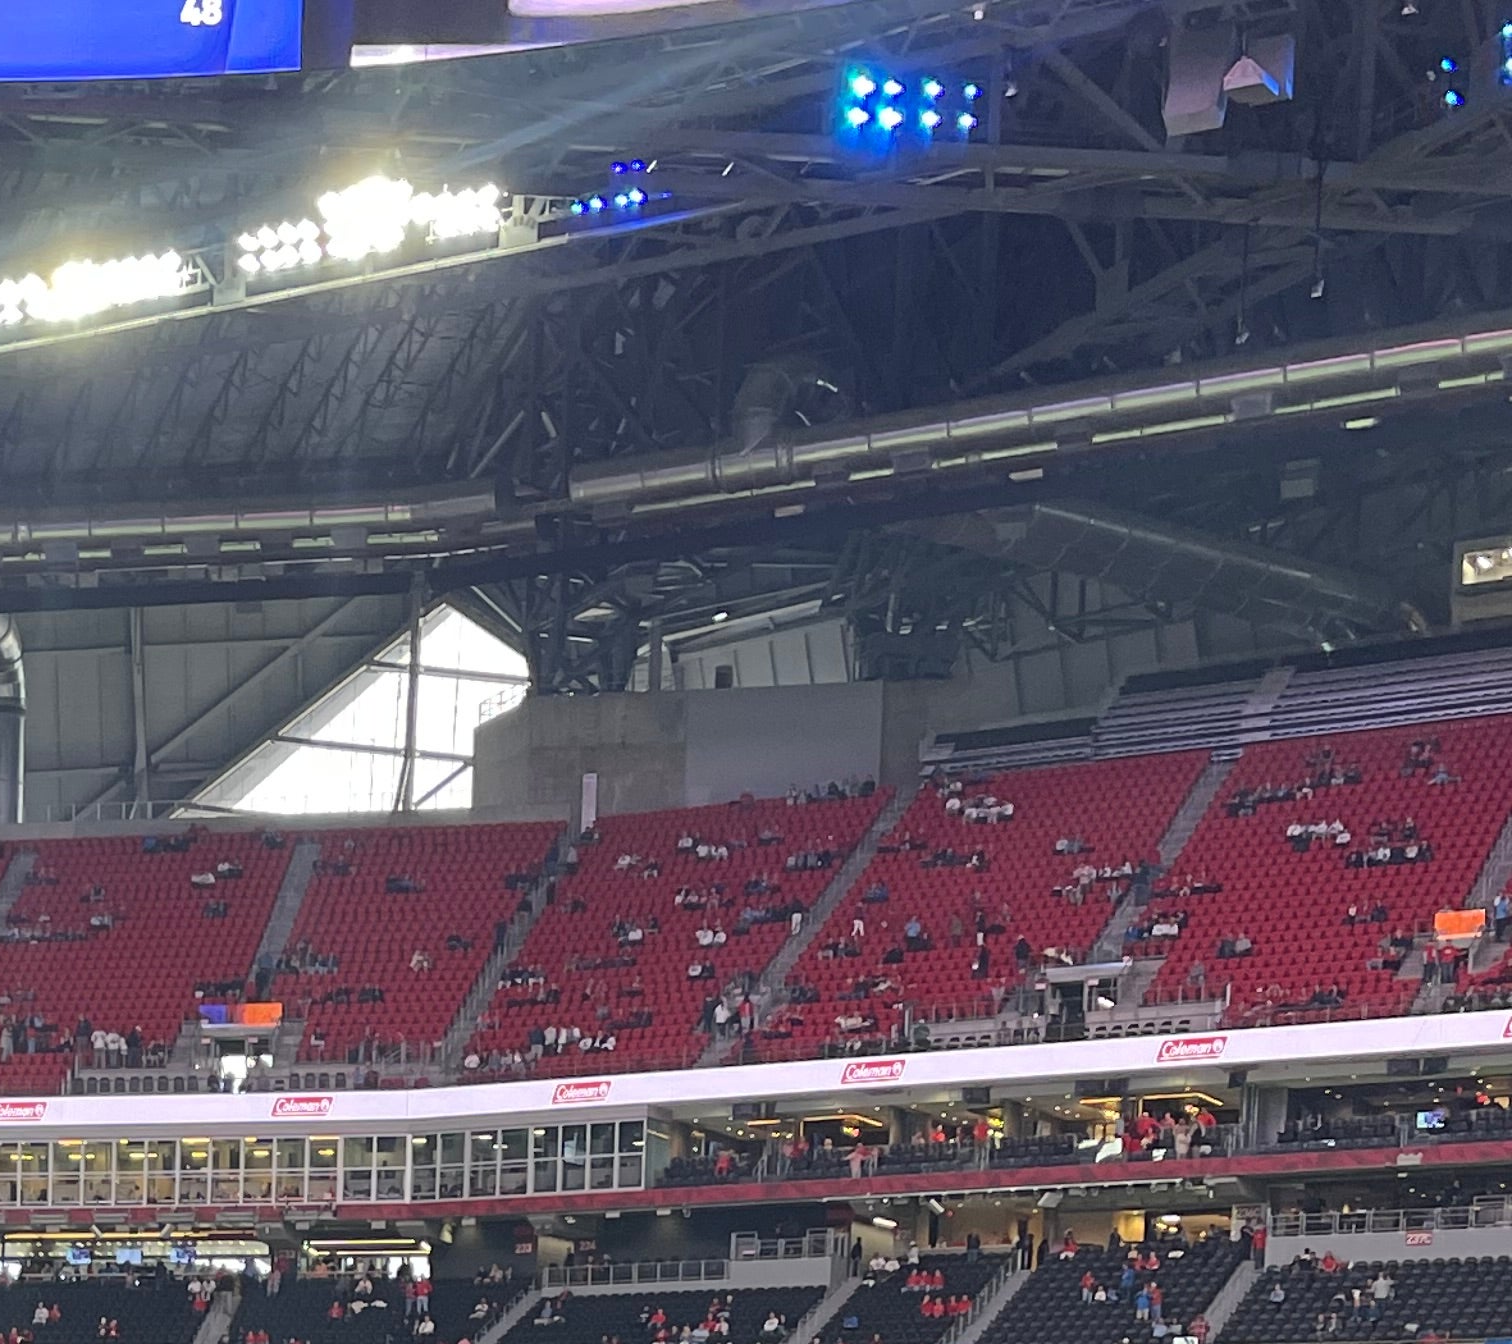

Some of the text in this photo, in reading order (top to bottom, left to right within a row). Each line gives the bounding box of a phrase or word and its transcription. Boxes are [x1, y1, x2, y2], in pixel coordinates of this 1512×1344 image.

[180, 0, 222, 26] 48
[1161, 1041, 1213, 1058] Coleman
[845, 1064, 892, 1080] Coleman
[556, 1084, 600, 1100] Coleman
[274, 1098, 320, 1112] Coleman
